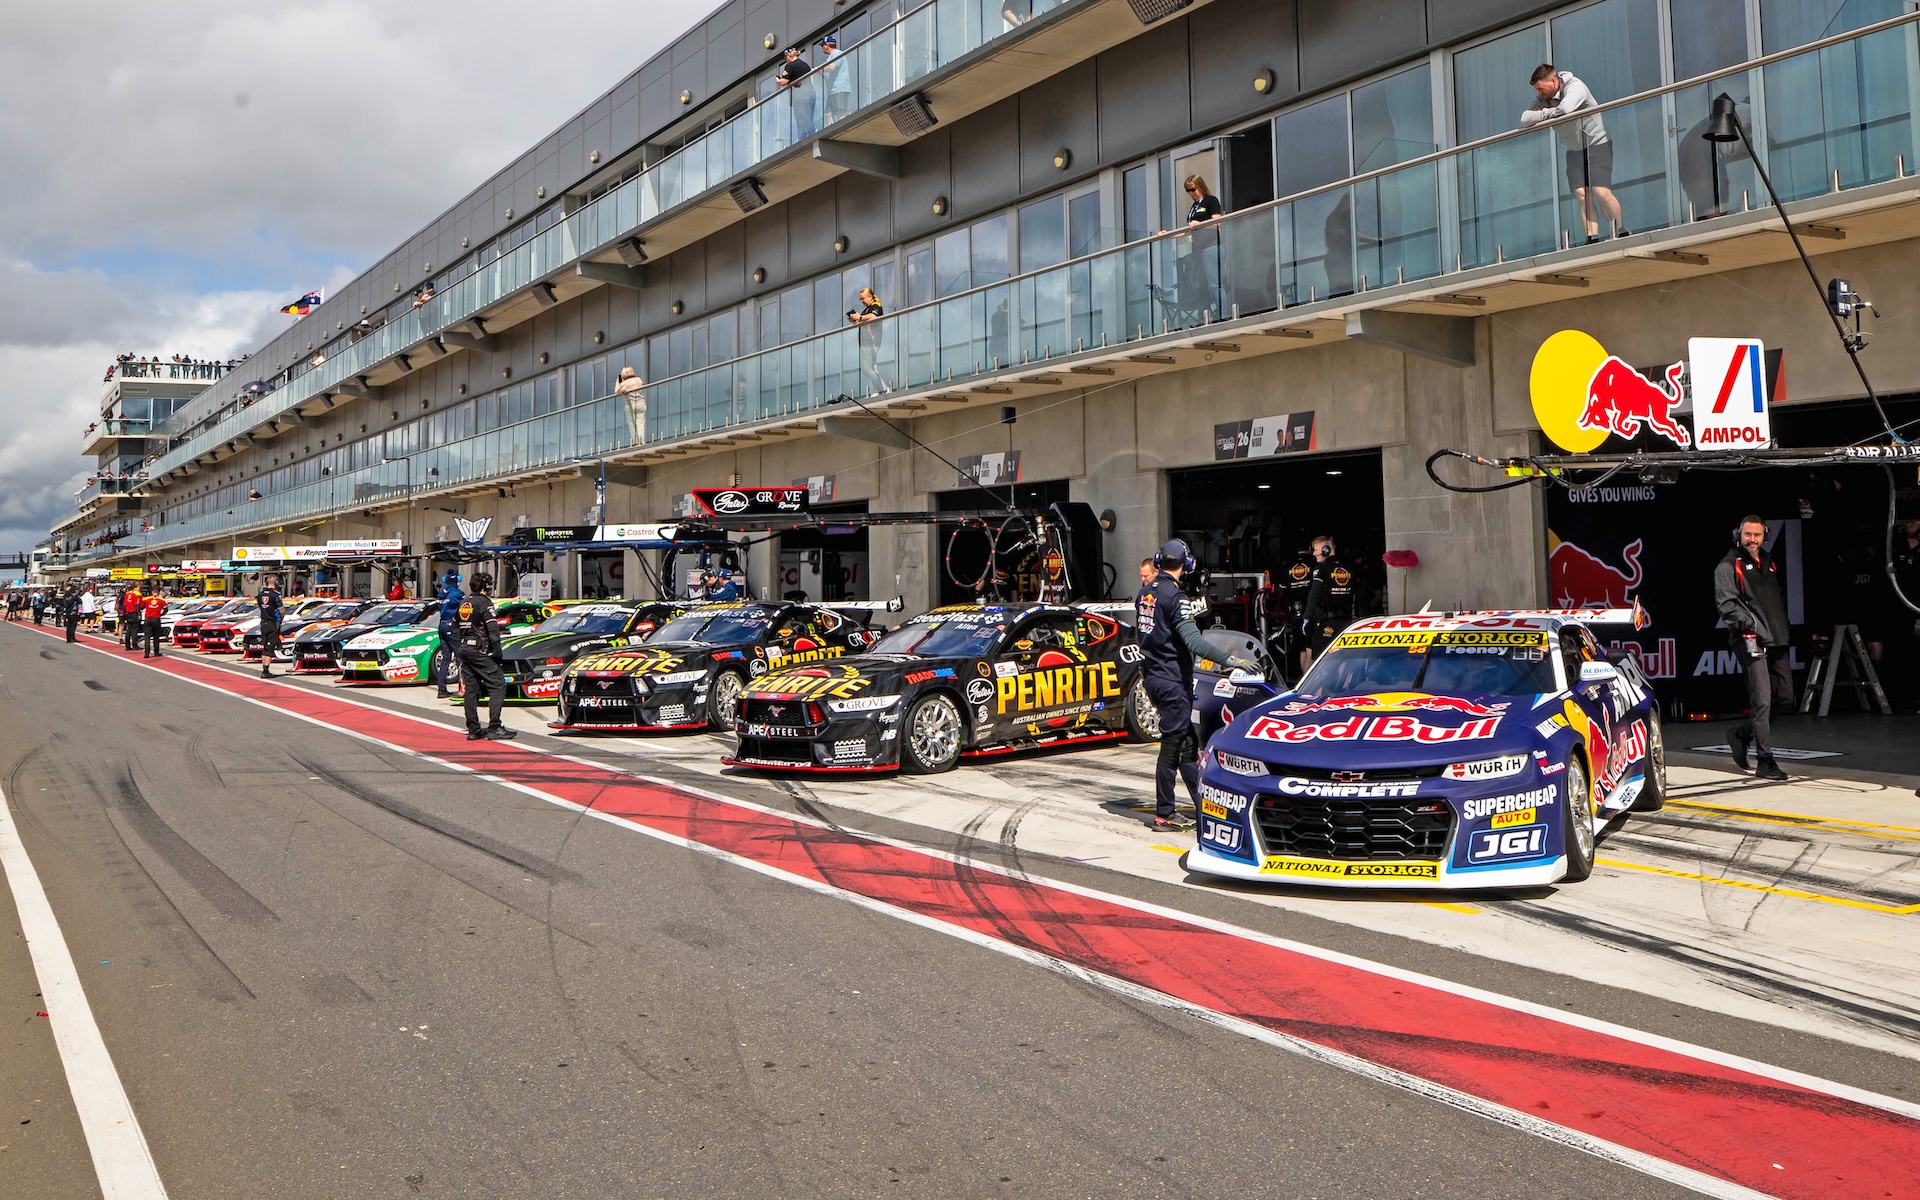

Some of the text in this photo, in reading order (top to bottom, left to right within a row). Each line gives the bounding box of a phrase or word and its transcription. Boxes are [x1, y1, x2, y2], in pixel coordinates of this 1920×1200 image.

[1238, 431, 1249, 446] 26
[1700, 427, 1766, 444] AMPOL
[972, 464, 980, 477] 19
[717, 494, 746, 510] Gates
[756, 491, 802, 503] GROVE
[1568, 485, 1656, 503] GIVES YOU WINGS
[777, 502, 801, 511] Racing
[627, 528, 655, 536] Castrol
[525, 614, 534, 623] 55
[955, 623, 979, 631] Allen
[848, 630, 882, 648] GROVE
[1062, 631, 1076, 647] 26
[1337, 632, 1539, 647] NATIONAL STORAGE
[1445, 646, 1509, 656] Feeney
[386, 667, 418, 678] RYCO
[570, 657, 684, 674] PENRITE
[666, 672, 699, 683] GROVE
[996, 650, 1122, 715] PENRITE
[579, 695, 628, 709] APEX STEEL
[846, 697, 887, 710] GROVE
[1012, 712, 1047, 725] AUSTRALIAN
[1046, 710, 1064, 719] OWNED
[1064, 706, 1080, 716] SINCE
[748, 723, 799, 740] APEX STEEL
[1245, 716, 1369, 744] Red
[1363, 716, 1504, 745] Bull
[1225, 754, 1261, 773] WÜRTH
[1468, 758, 1521, 775] WÜRTH
[1278, 777, 1420, 797] COMPLETE
[1198, 777, 1248, 814] PERCHEAP
[1463, 784, 1558, 820] SUPERCHEAP
[1204, 802, 1225, 816] AUTO
[1496, 812, 1531, 825] AUTO
[1203, 820, 1240, 848] JGI
[1475, 829, 1542, 858] JGI
[1264, 860, 1432, 876] NATIONAL STORAGE
